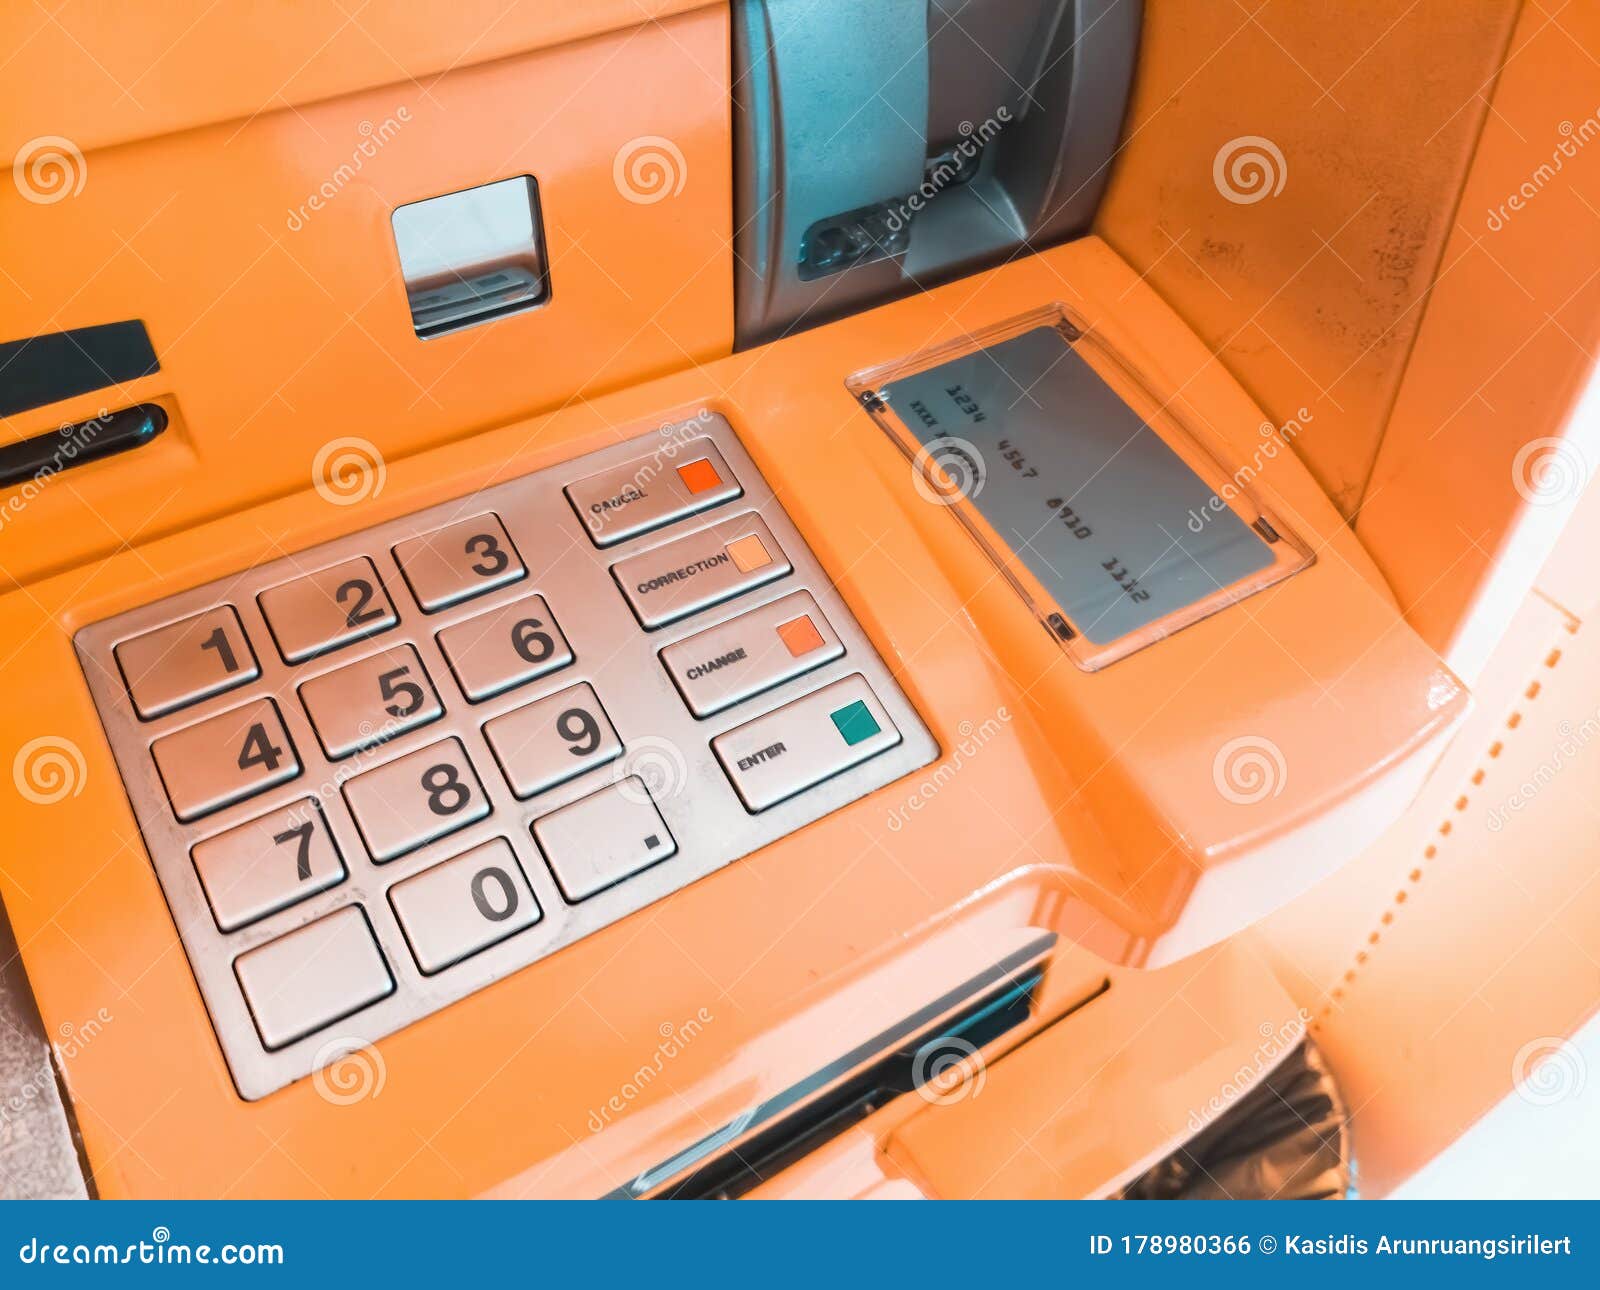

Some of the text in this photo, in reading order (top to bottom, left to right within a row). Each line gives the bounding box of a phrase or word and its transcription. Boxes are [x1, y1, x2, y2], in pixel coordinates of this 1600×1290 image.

[591, 489, 648, 514] CANCEL
[945, 384, 987, 423] 1234
[998, 439, 1038, 480] 4567
[1101, 557, 1150, 603] 1112
[463, 533, 509, 577] 3
[637, 552, 728, 595] CORRECTION
[335, 578, 385, 627] 2
[200, 627, 240, 673] 1
[511, 618, 556, 663] 6
[686, 647, 748, 681] CHANGE
[378, 666, 425, 717] 5
[237, 723, 283, 772] 4
[556, 708, 602, 756] 9
[737, 741, 788, 772] ENTER
[421, 763, 471, 816] 8
[273, 821, 315, 881] 7
[471, 866, 519, 923] 0
